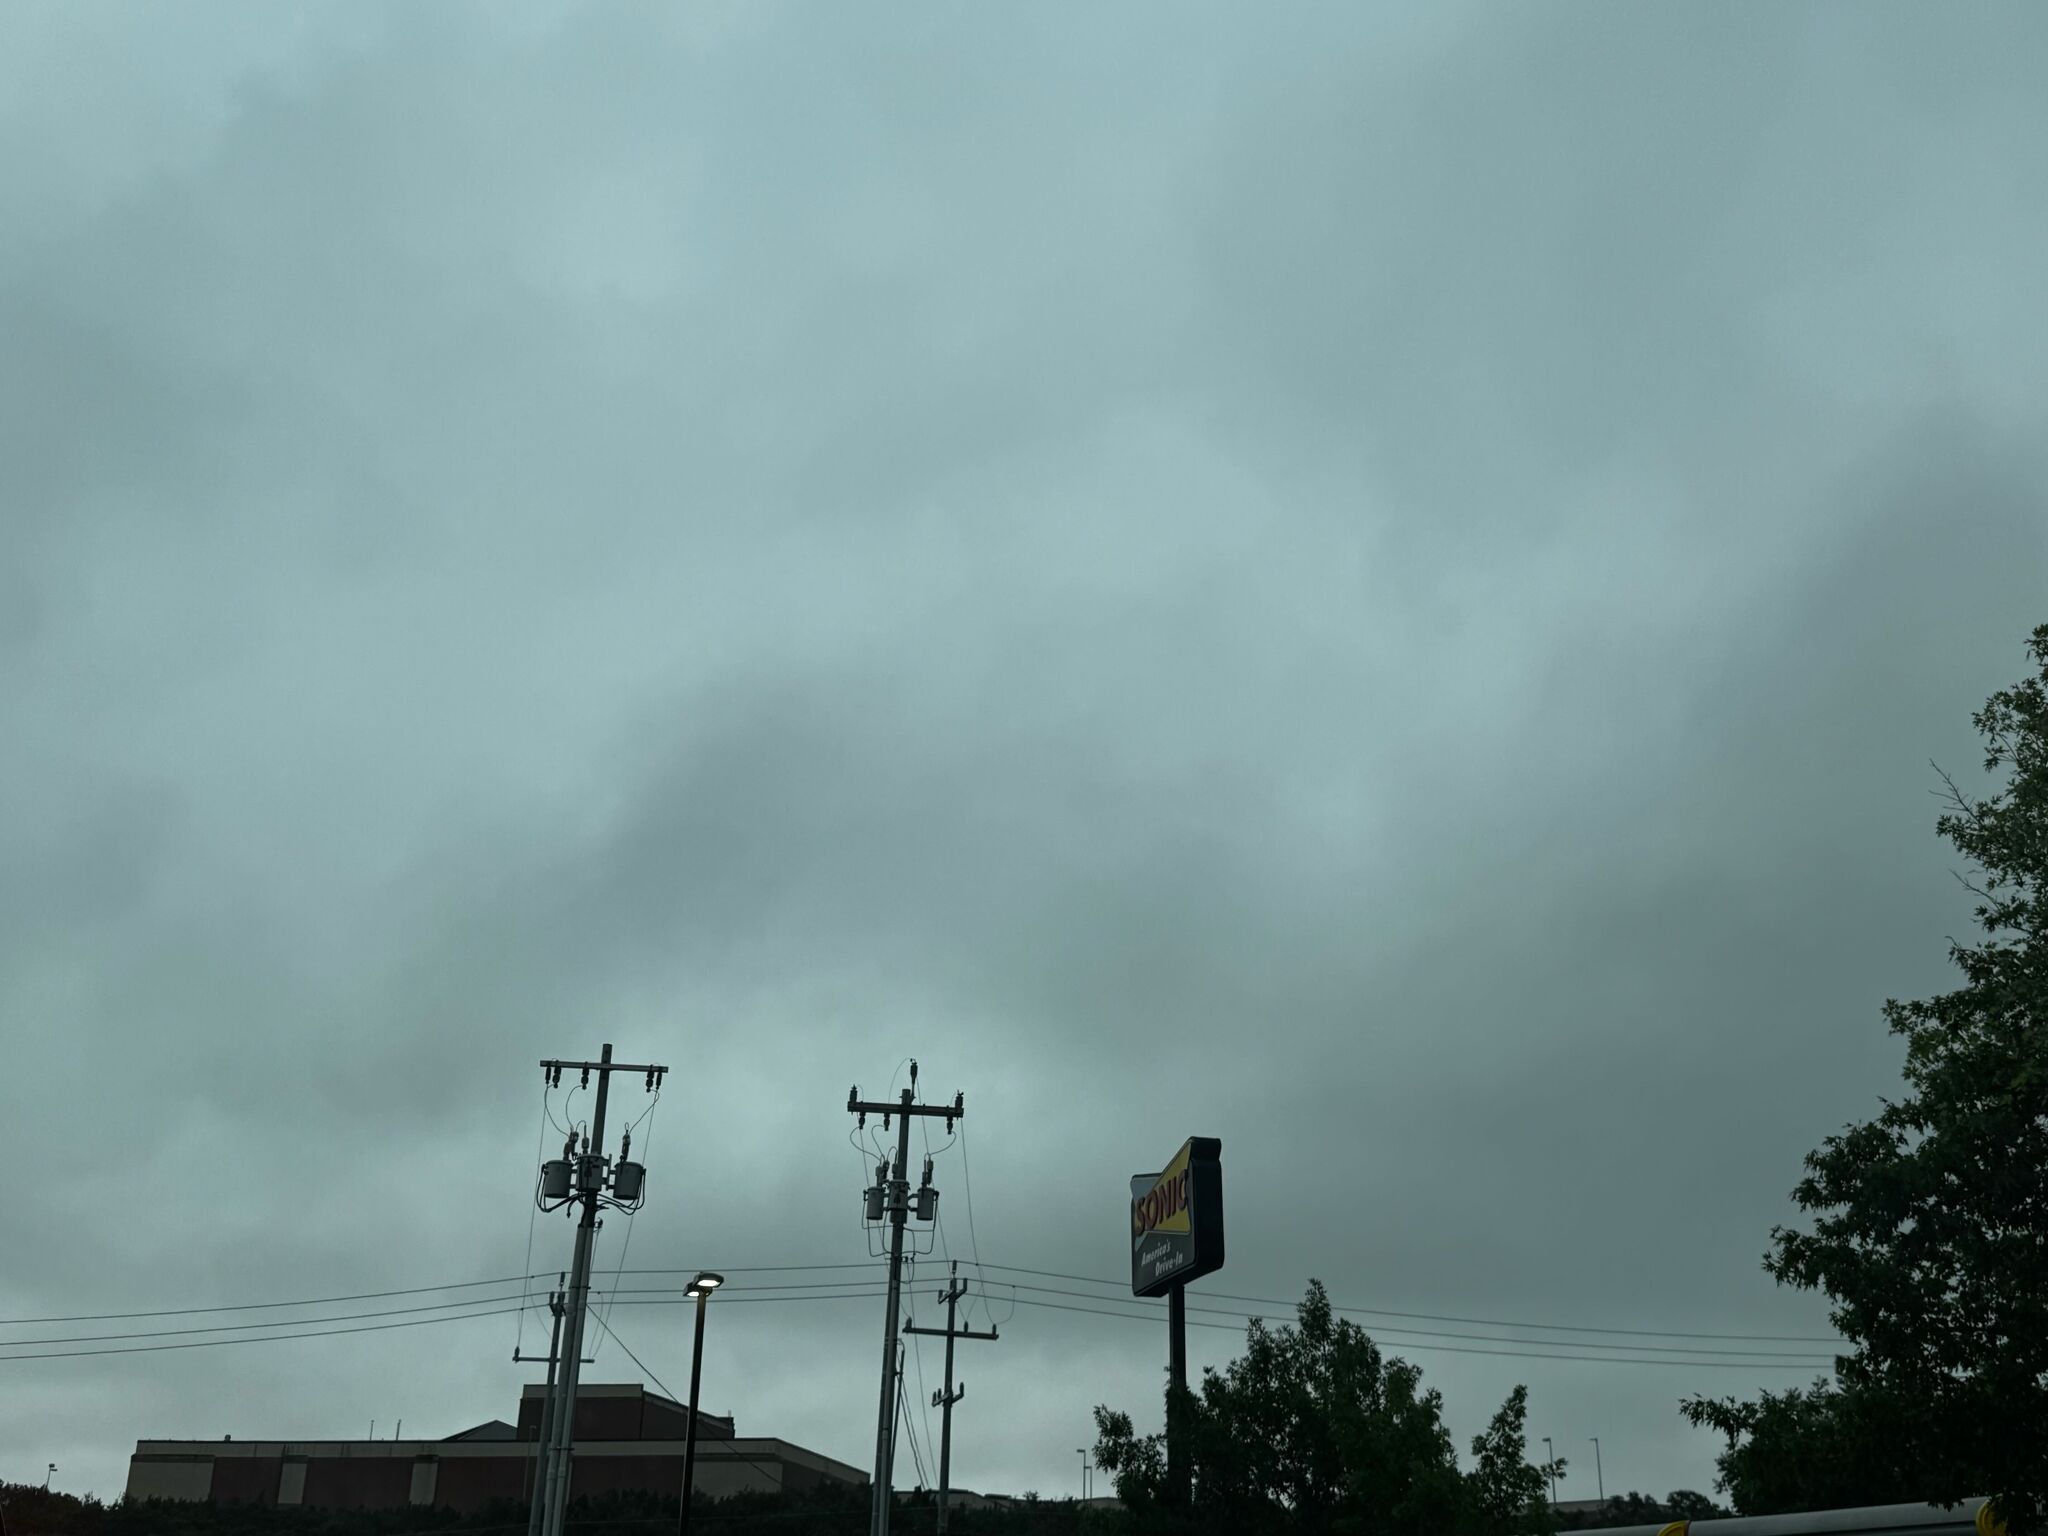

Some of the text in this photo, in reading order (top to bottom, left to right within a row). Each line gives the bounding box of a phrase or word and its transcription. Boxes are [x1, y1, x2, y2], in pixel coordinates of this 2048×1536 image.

[1134, 1168, 1188, 1238] SONIC
[1141, 1239, 1171, 1266] America's
[1155, 1250, 1183, 1277] Drive-In
